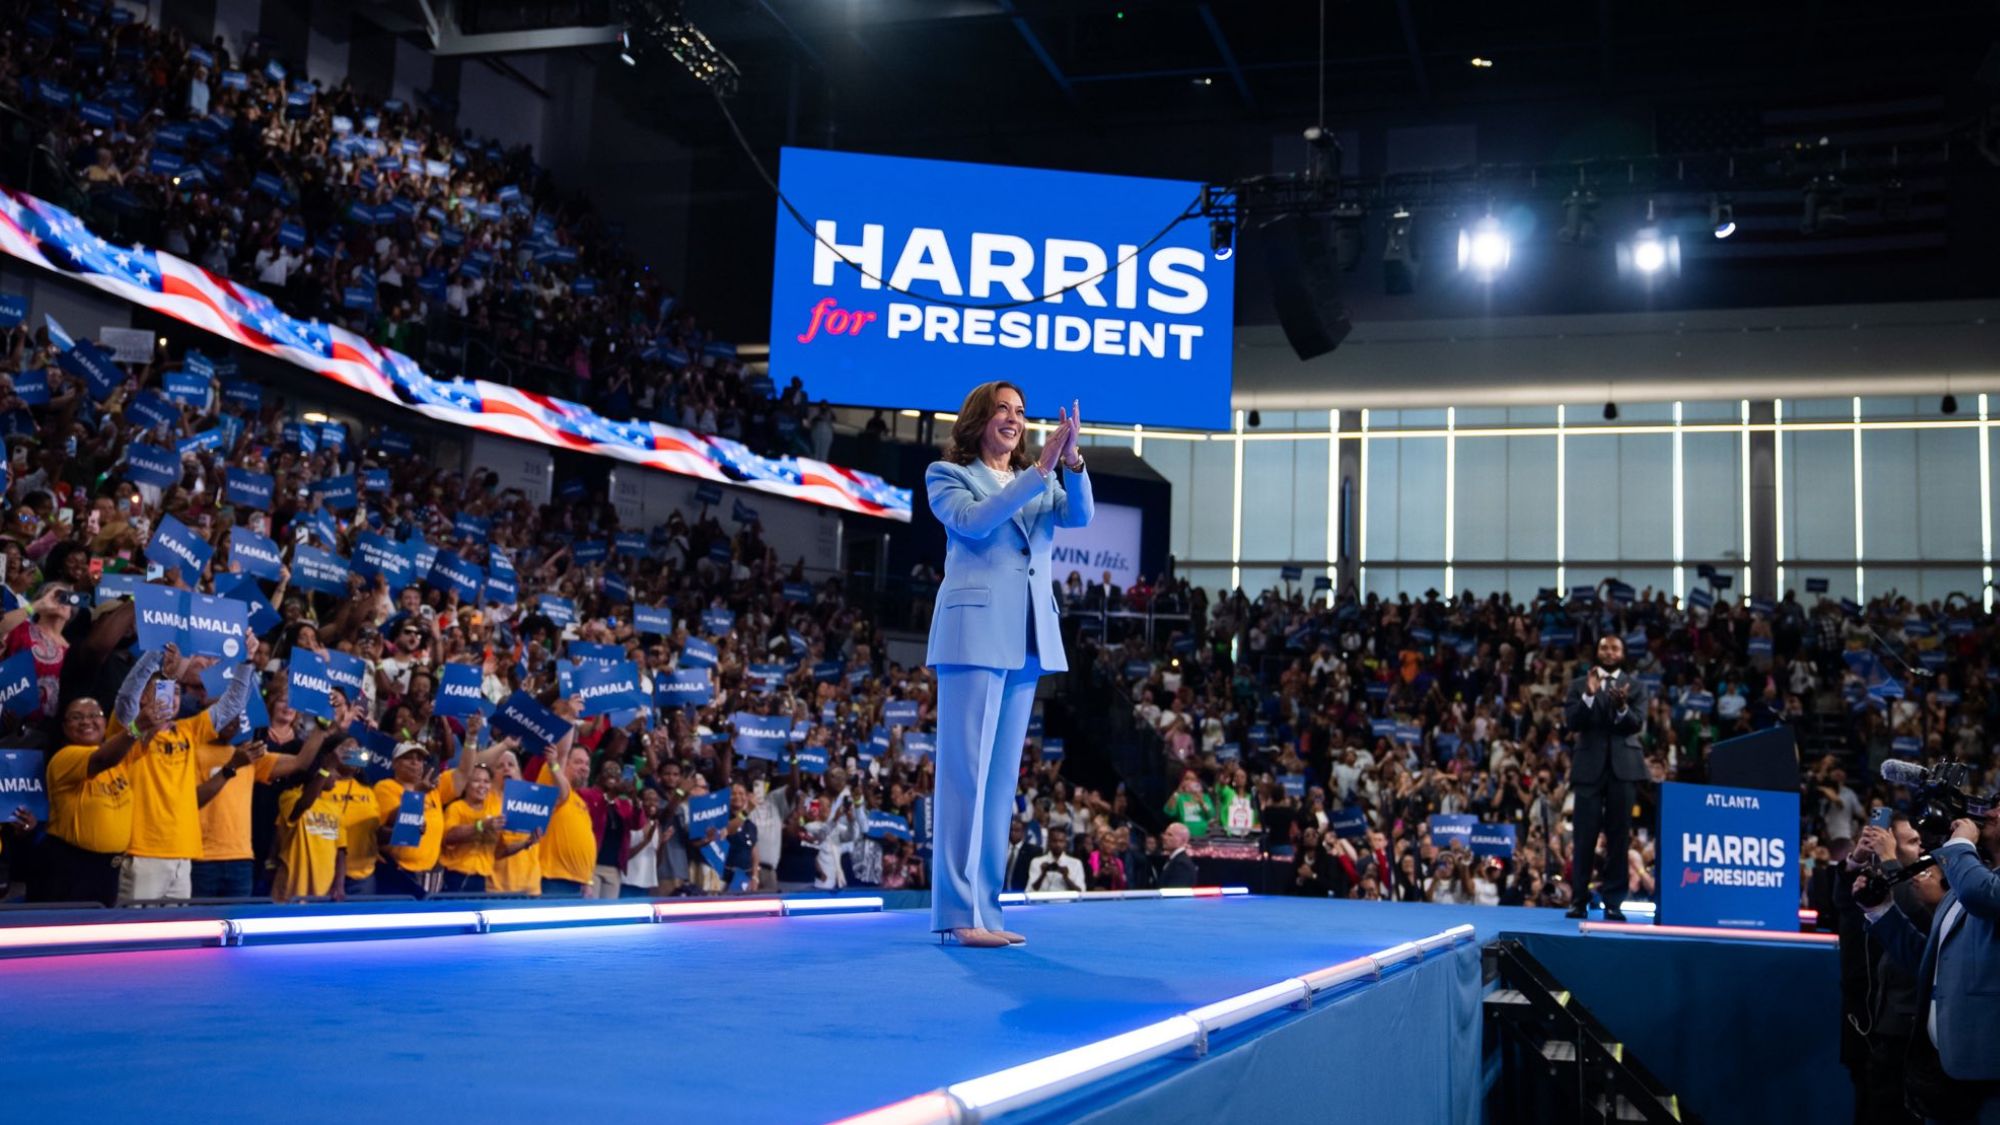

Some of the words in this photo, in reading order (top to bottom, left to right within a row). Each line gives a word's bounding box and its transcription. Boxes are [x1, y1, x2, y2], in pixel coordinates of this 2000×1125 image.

[812, 219, 1209, 315] HARRIS
[797, 298, 877, 344] for
[888, 303, 1204, 360] PRESIDENT
[72, 350, 110, 387] KAMALA
[129, 456, 174, 475] KAMALA
[229, 480, 268, 496] KAMALA
[158, 533, 201, 571] KAMALA
[234, 543, 282, 564] KAMALA
[435, 564, 476, 590] KAMALA
[189, 615, 243, 637] AMALA
[636, 615, 669, 625] KAMALA
[686, 648, 718, 662] KAMALA
[445, 683, 482, 699] KAMA
[580, 680, 634, 699] KAMALA
[658, 682, 704, 693] KAMALA
[505, 706, 554, 743] KAMALA
[740, 726, 786, 739] KAMALA
[507, 799, 548, 817] KAMALA
[1706, 793, 1759, 810] ATLANTA
[868, 820, 906, 831] KAMALA
[1471, 835, 1511, 845] KAMALA
[1682, 833, 1787, 868] HARRIS
[1680, 867, 1701, 887] for
[1703, 868, 1786, 888] PRESIDENT
